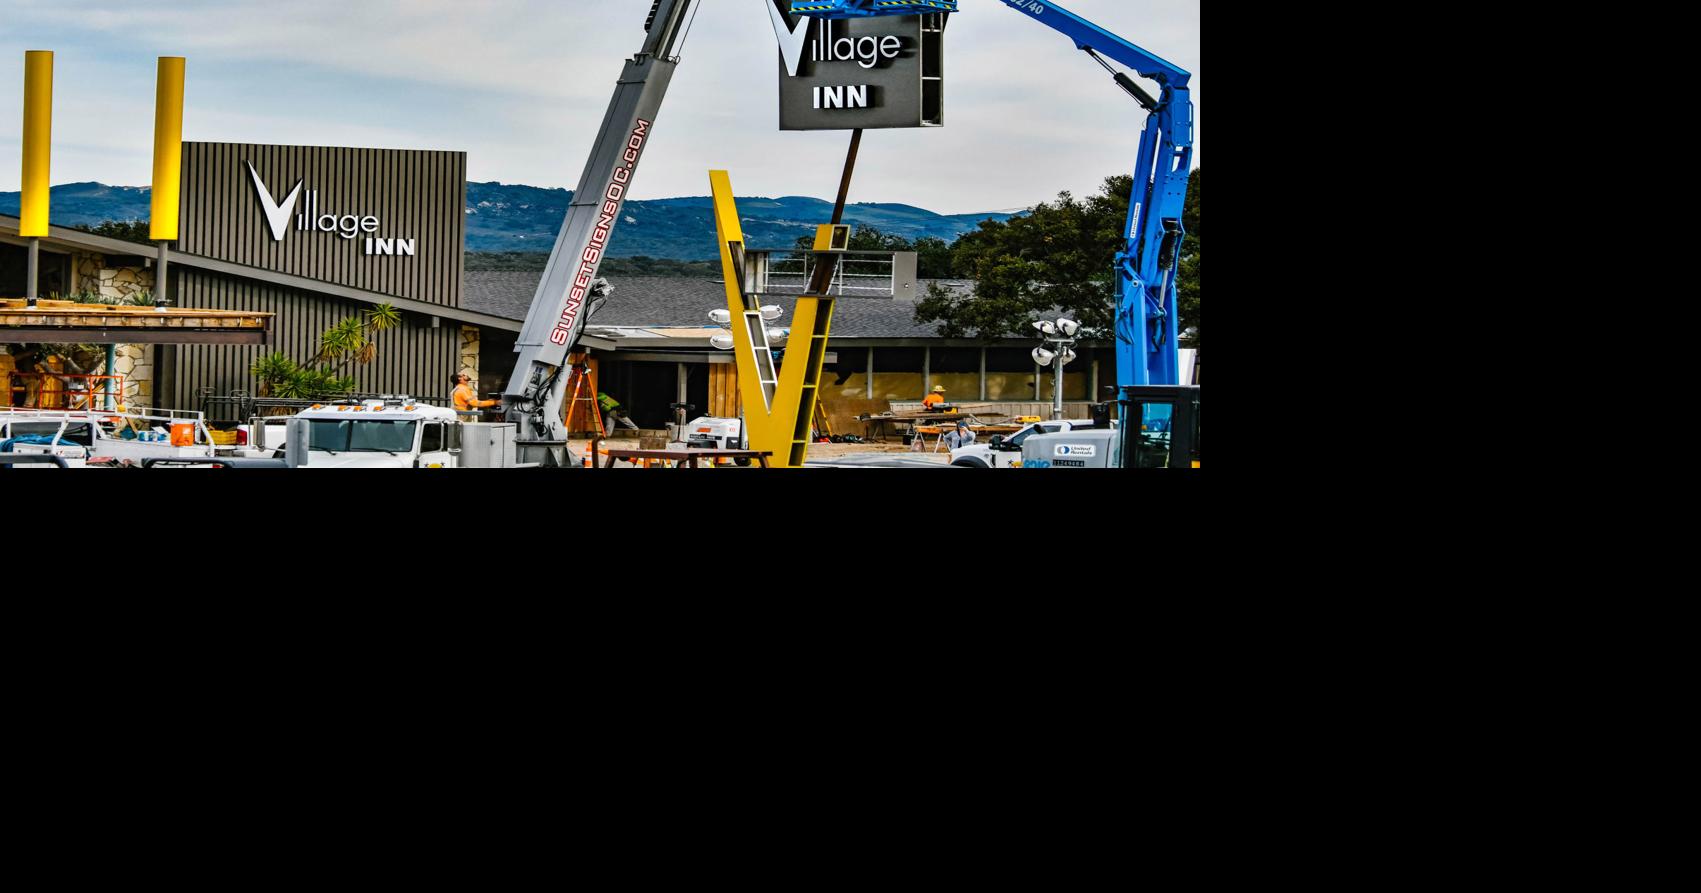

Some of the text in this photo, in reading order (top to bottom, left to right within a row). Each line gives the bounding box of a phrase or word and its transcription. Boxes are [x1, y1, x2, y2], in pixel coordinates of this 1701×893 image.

[1010, 0, 1044, 14] 2/40
[765, 0, 901, 76] Village
[813, 85, 867, 108] INN
[247, 159, 379, 241] Village
[365, 237, 415, 256] INN
